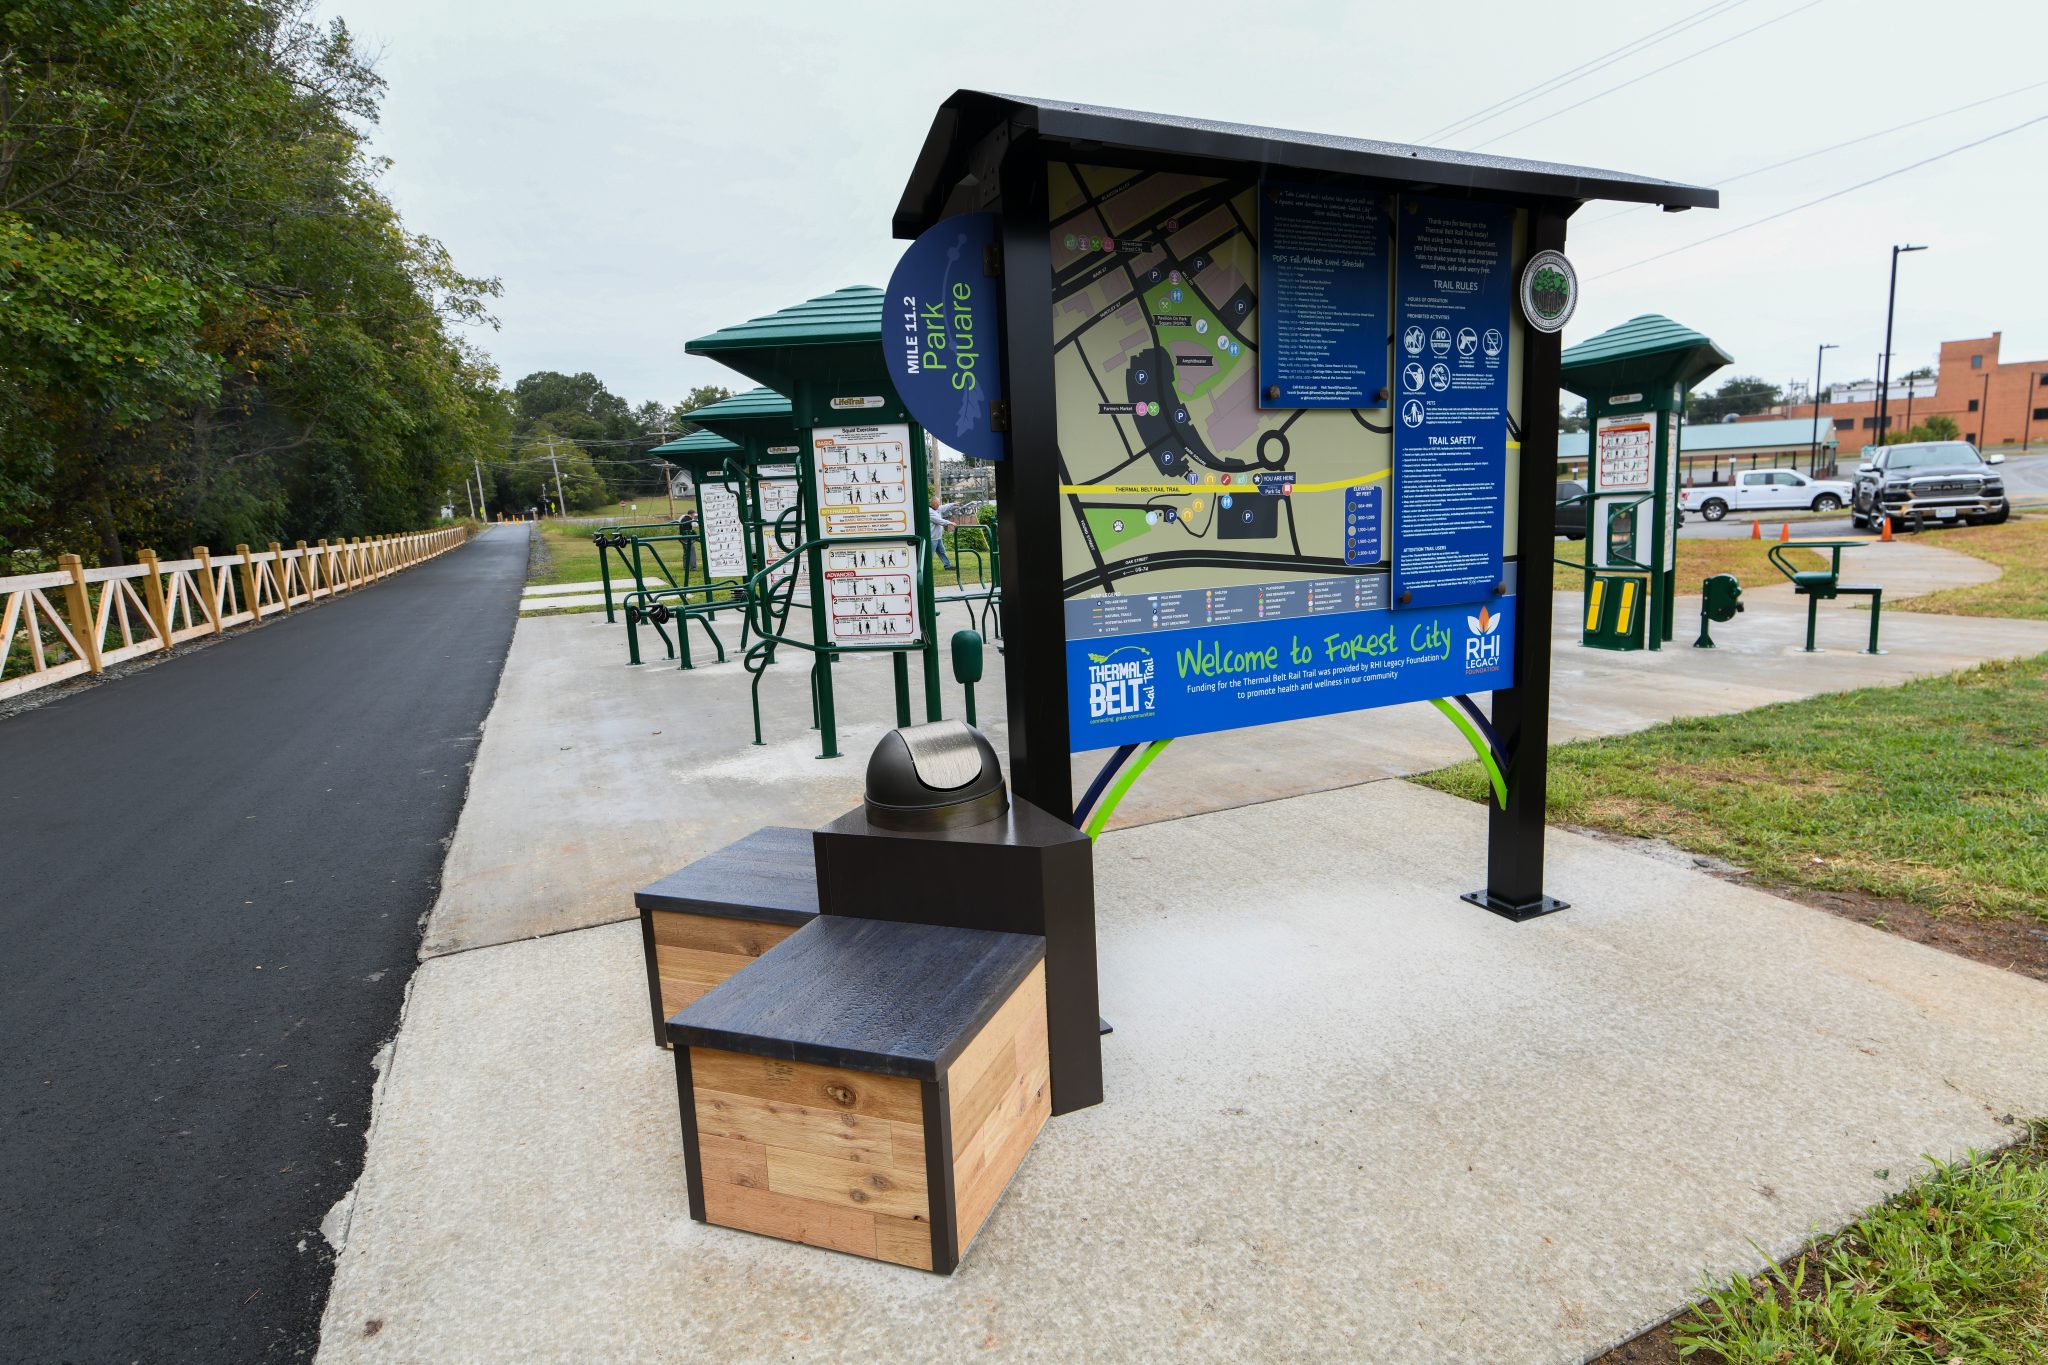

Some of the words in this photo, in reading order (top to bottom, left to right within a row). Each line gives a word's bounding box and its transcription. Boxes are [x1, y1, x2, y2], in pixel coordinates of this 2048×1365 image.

[1272, 254, 1288, 263] POPS
[1434, 280, 1454, 290] TRAIL
[1456, 281, 1478, 290] RULES
[903, 296, 918, 332] 11.2
[920, 301, 948, 370] Park
[952, 282, 980, 392] Square
[1436, 330, 1446, 340] NO
[906, 336, 920, 374] MILE
[834, 398, 865, 406] LifeTrail
[816, 440, 833, 448] BASIC
[1428, 436, 1449, 445] TRAIL
[1450, 436, 1476, 445] SAFETY
[1276, 488, 1282, 496] Sq
[1177, 640, 1278, 679] Welcome
[1290, 635, 1312, 665] to
[1324, 624, 1399, 662] Forest
[1411, 619, 1451, 660] City
[1466, 634, 1500, 661] RHI
[1089, 661, 1143, 683] THERMAL
[1142, 657, 1154, 684] Trail
[1187, 684, 1216, 694] Funding
[1217, 682, 1228, 692] for
[1229, 679, 1241, 689] the
[1243, 675, 1271, 687] Thermal
[1273, 672, 1286, 683] Belt
[1288, 670, 1301, 681] Rail
[1302, 668, 1317, 679] Trail
[1318, 669, 1332, 677] was
[1332, 664, 1360, 677] provided
[1361, 662, 1369, 672] by
[1370, 660, 1382, 670] RHI
[1383, 657, 1405, 668] Legacy
[1406, 654, 1440, 666] Foundation
[1466, 656, 1500, 670] LEGACY
[1466, 666, 1500, 676] FOUNDATION
[1237, 690, 1246, 699] to
[1247, 688, 1276, 700] promote
[1277, 683, 1299, 694] health
[1300, 681, 1313, 691] and
[1314, 678, 1342, 690] wellness
[1344, 676, 1350, 685] in
[1351, 676, 1362, 684] our
[1363, 671, 1398, 683] community
[1090, 678, 1143, 718] BELT
[1143, 686, 1155, 710] Rail
[1090, 716, 1114, 724] connecting
[1115, 714, 1128, 722] great
[1128, 712, 1156, 720] communities
